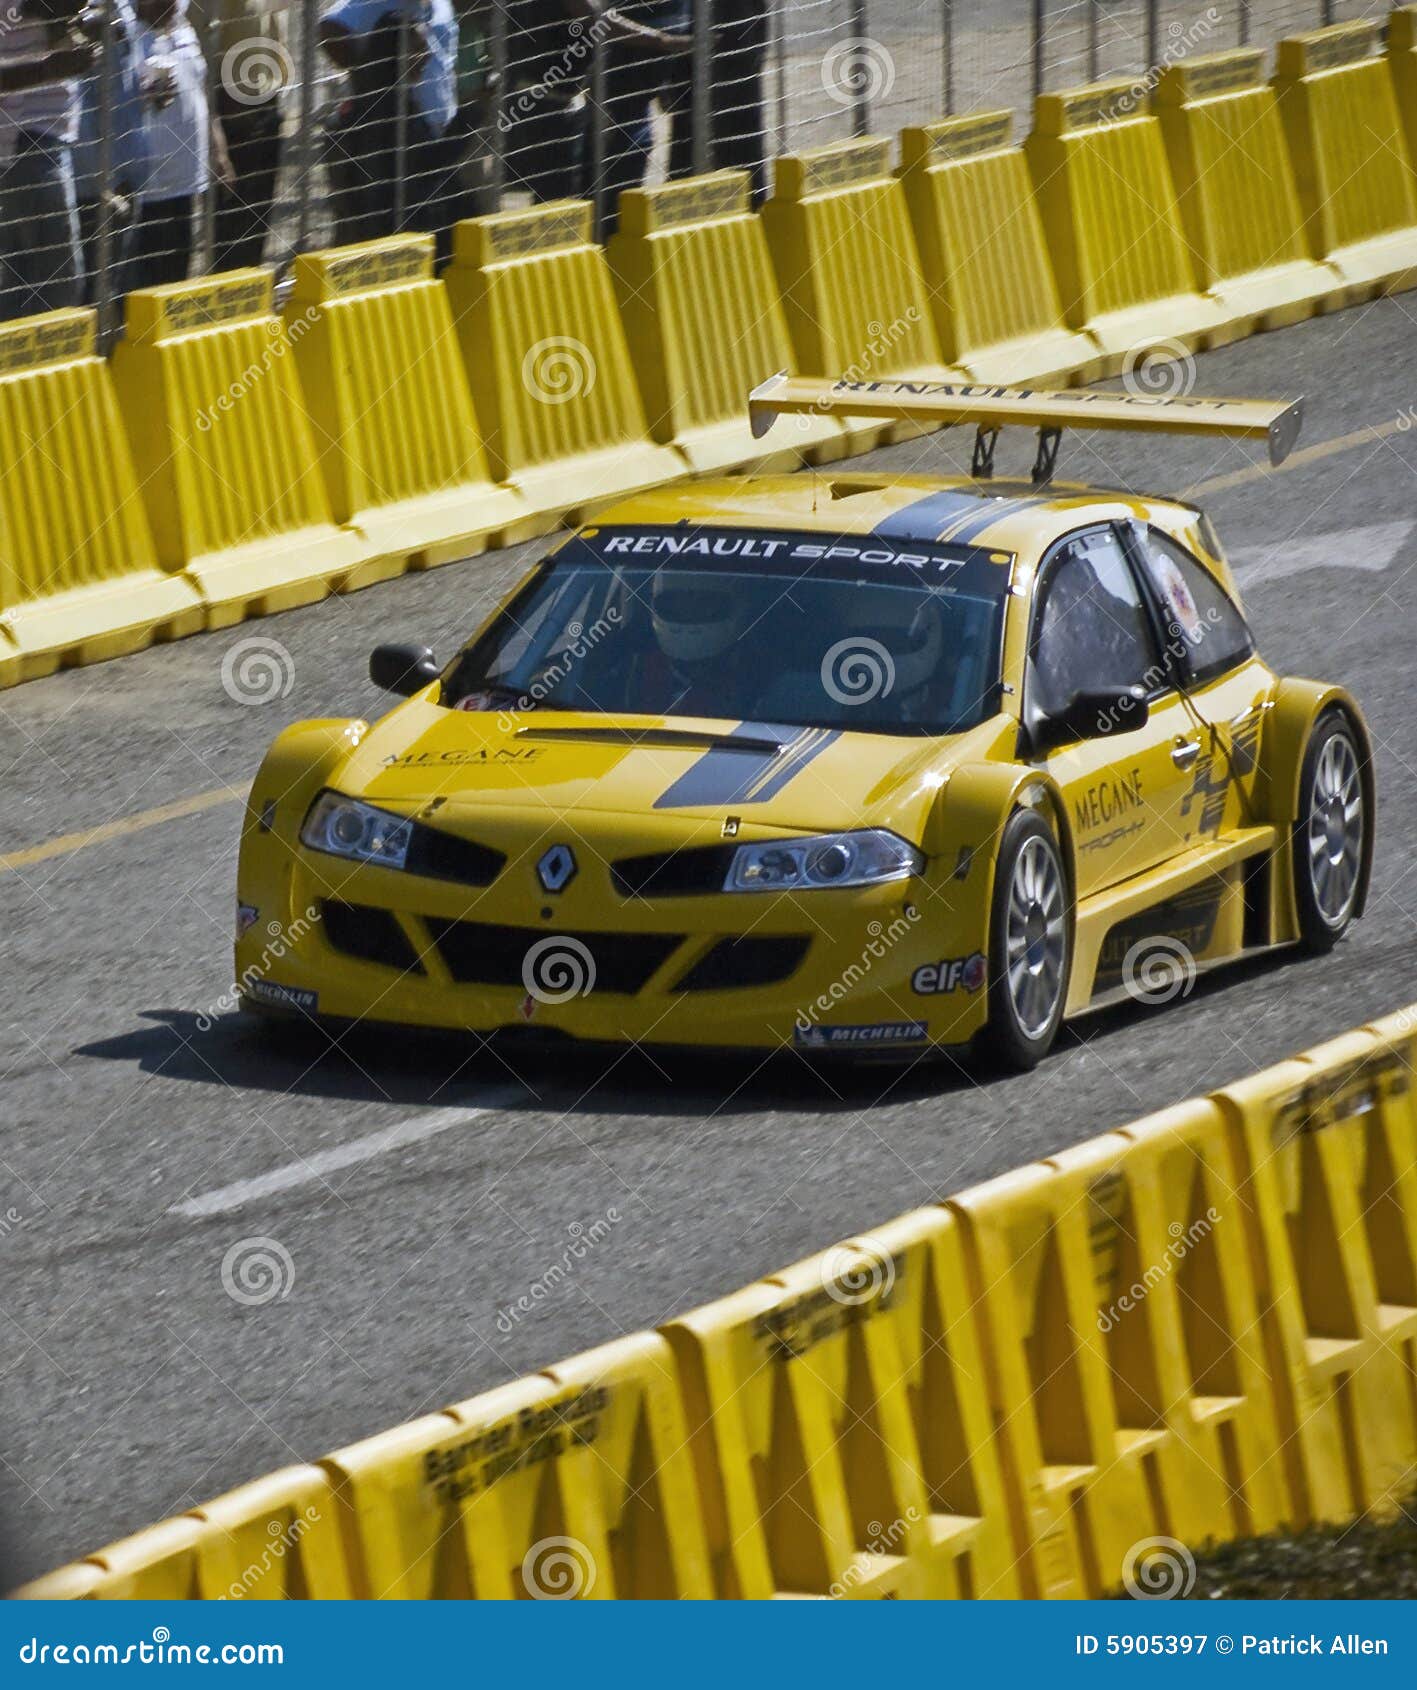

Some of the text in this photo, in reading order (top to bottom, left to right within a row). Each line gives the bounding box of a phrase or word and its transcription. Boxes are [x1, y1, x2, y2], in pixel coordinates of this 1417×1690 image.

[833, 380, 1244, 410] RENAULT SPORT
[604, 536, 966, 571] RENAULT SPORT
[1075, 768, 1145, 834] MEGANE
[912, 960, 964, 993] elf
[831, 1025, 924, 1041] MICHELIN
